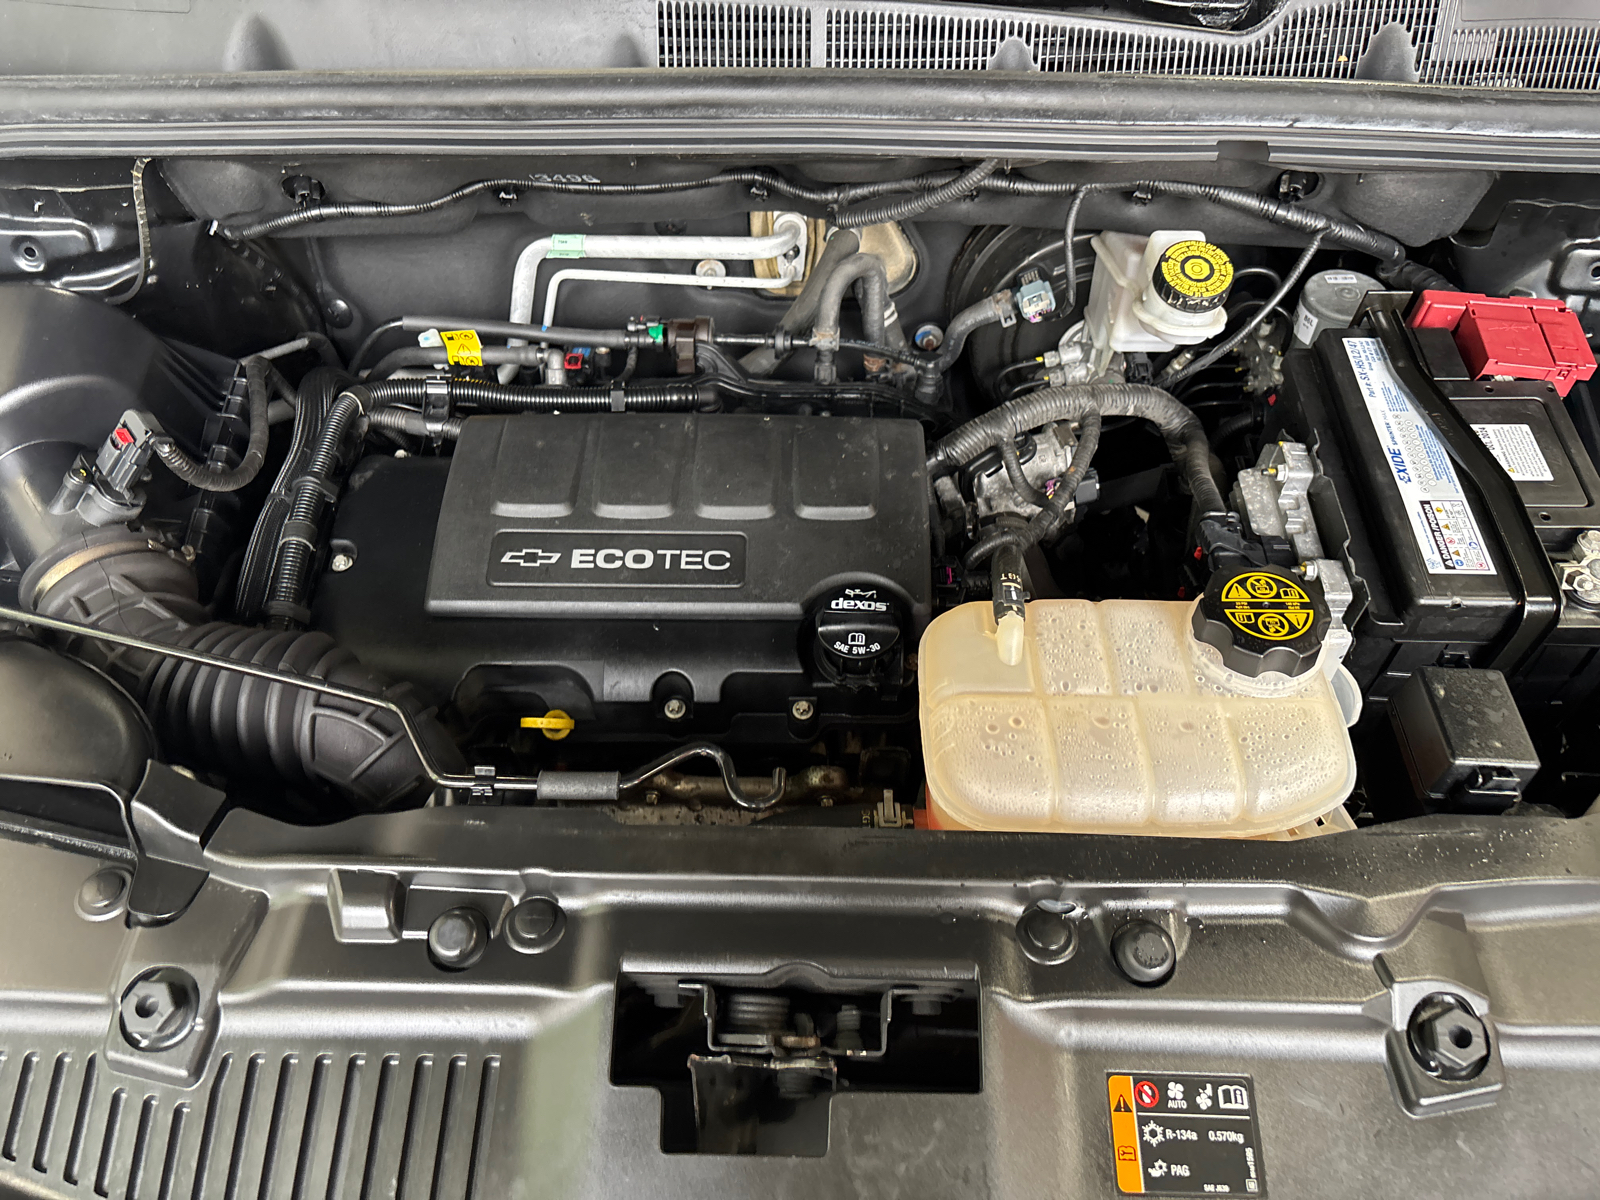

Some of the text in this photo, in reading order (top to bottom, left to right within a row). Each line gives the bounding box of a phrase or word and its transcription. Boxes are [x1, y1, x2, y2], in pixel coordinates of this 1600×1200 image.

[1387, 447, 1412, 484] EXIDE
[1434, 531, 1451, 559] DANGER
[571, 549, 731, 570] ECOTEC
[831, 597, 887, 612] dexos
[834, 641, 881, 654] SAE 5W-30
[1168, 1100, 1187, 1109] AUTO
[1165, 1129, 1245, 1144] R-134a 0.570kg
[1170, 1164, 1190, 1177] PAG
